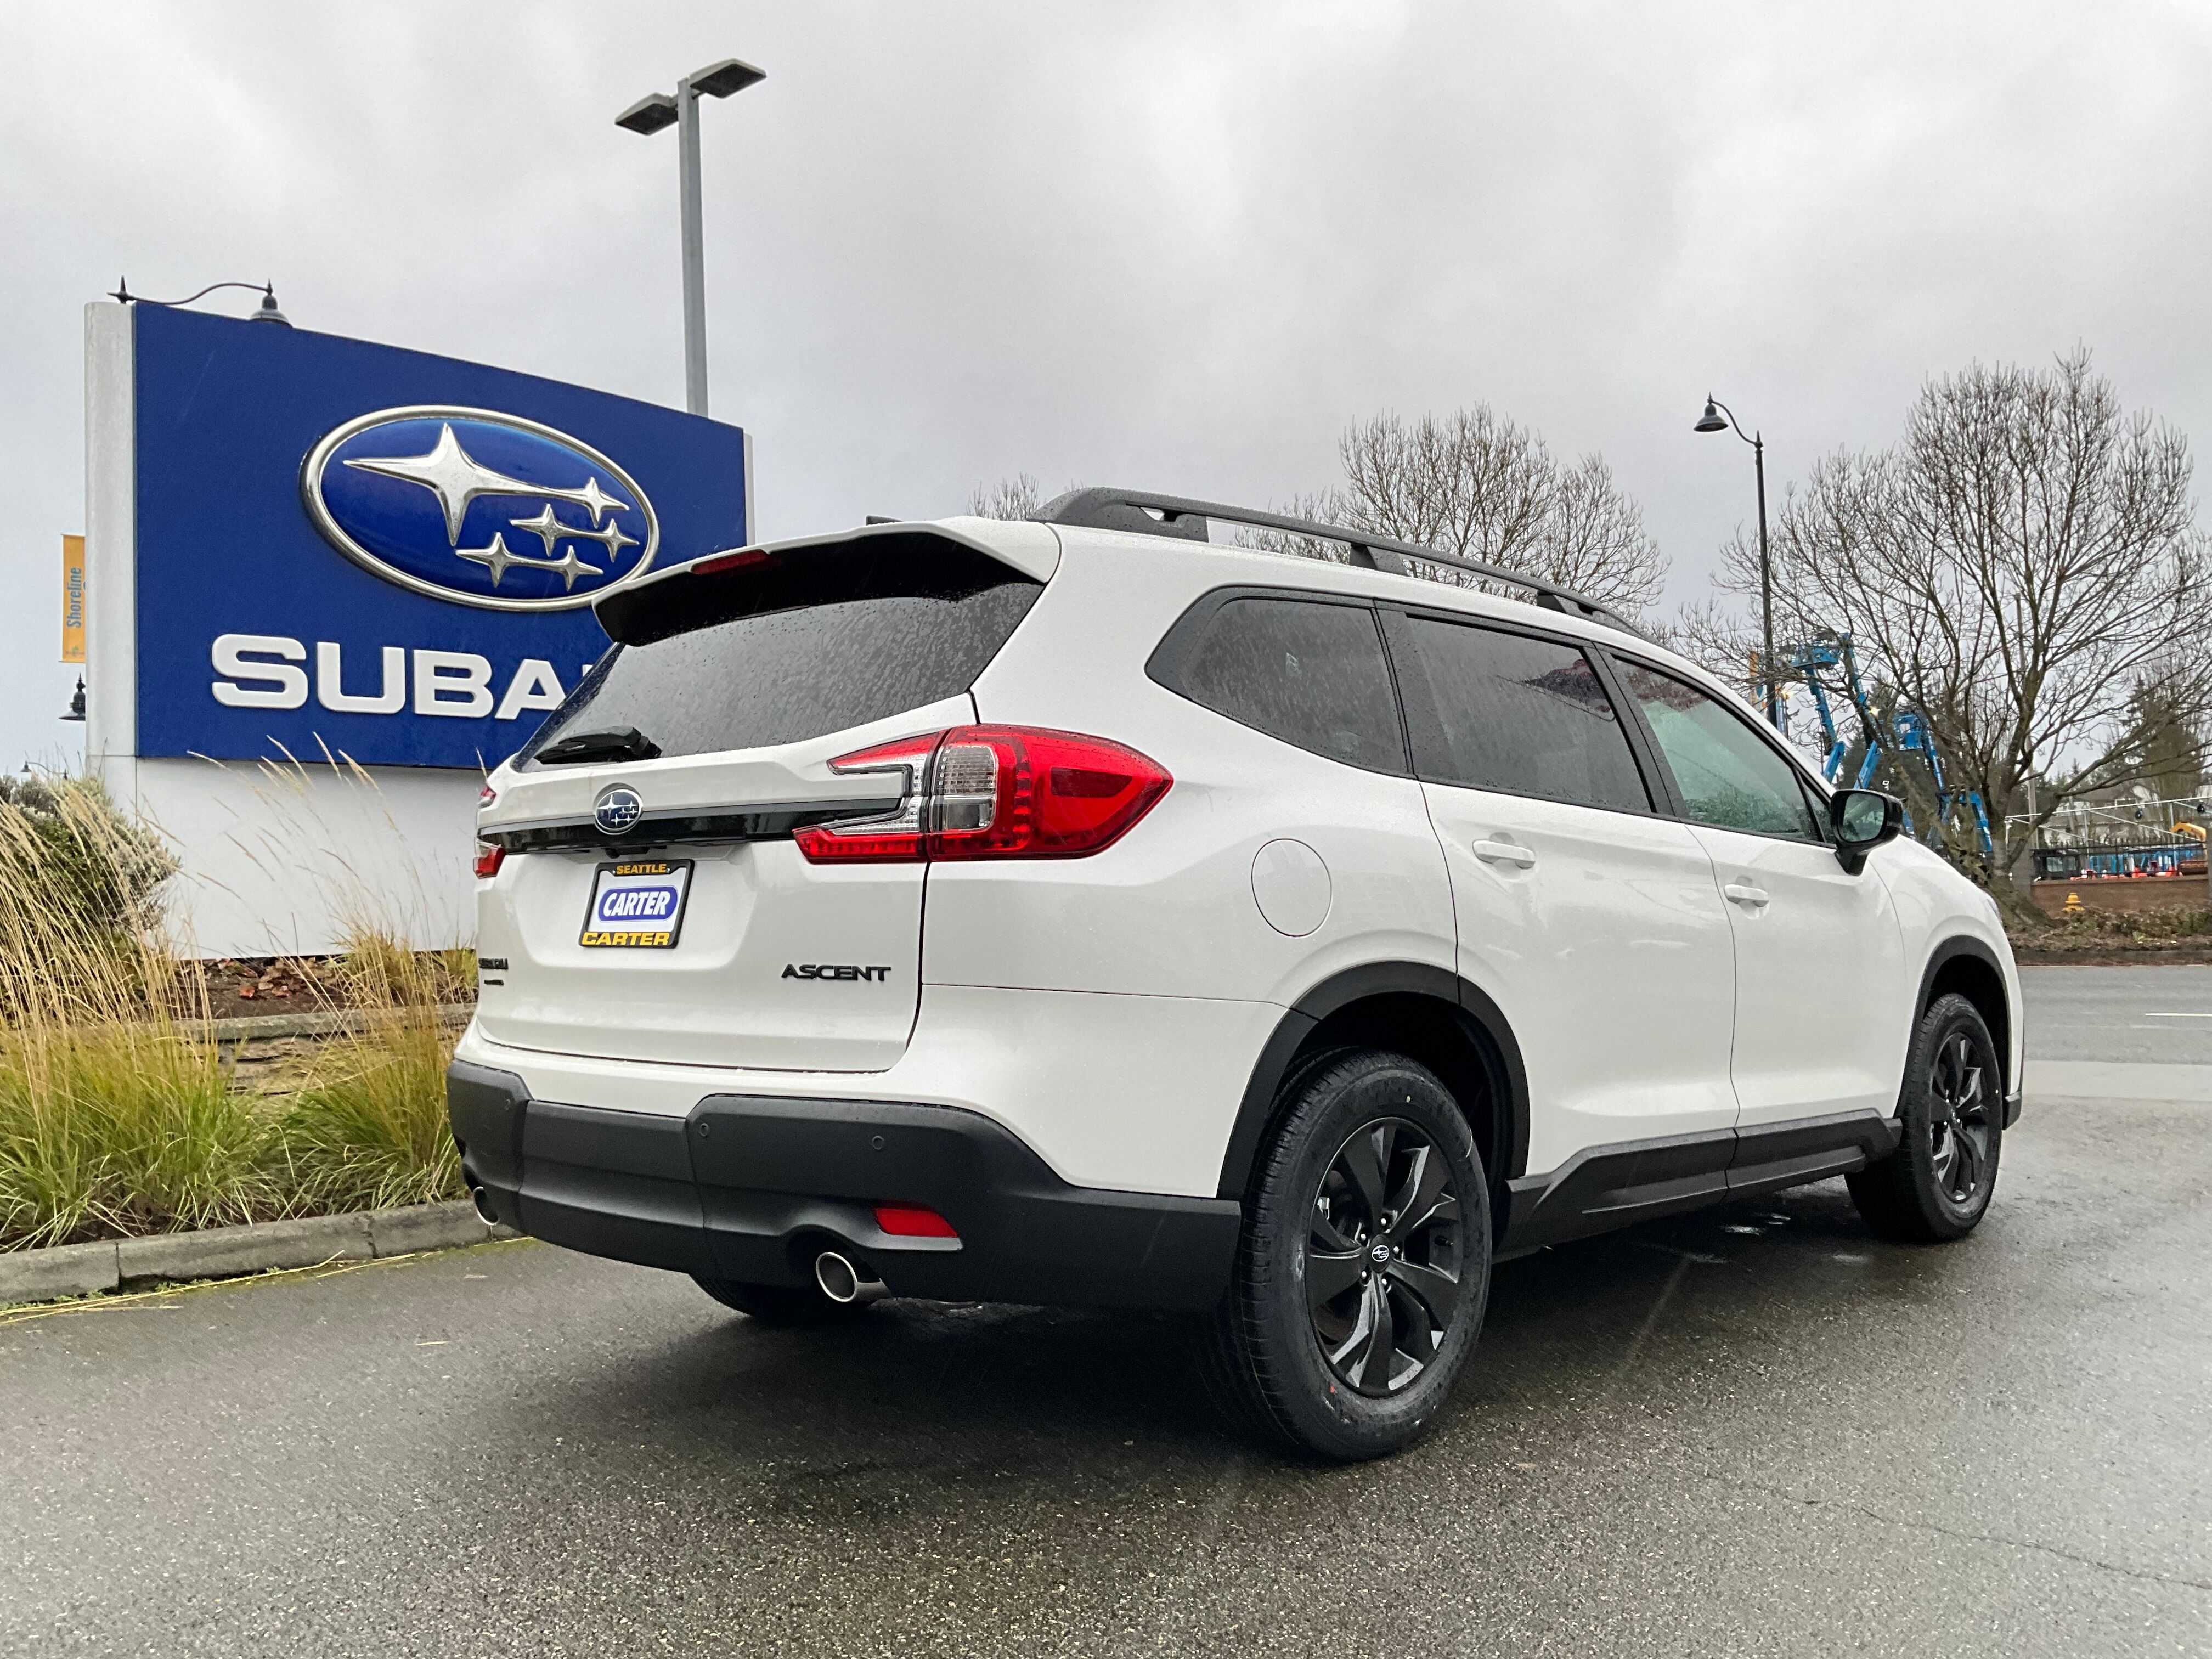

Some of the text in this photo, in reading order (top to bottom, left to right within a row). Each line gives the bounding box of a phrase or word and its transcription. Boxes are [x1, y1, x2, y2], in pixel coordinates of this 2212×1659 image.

[66, 567, 82, 628] Shoreline
[212, 633, 592, 720] SUBA
[616, 864, 667, 874] SEATTLE
[603, 891, 671, 917] CARTER
[582, 932, 670, 946] CARTER
[781, 964, 891, 981] ASCENT
